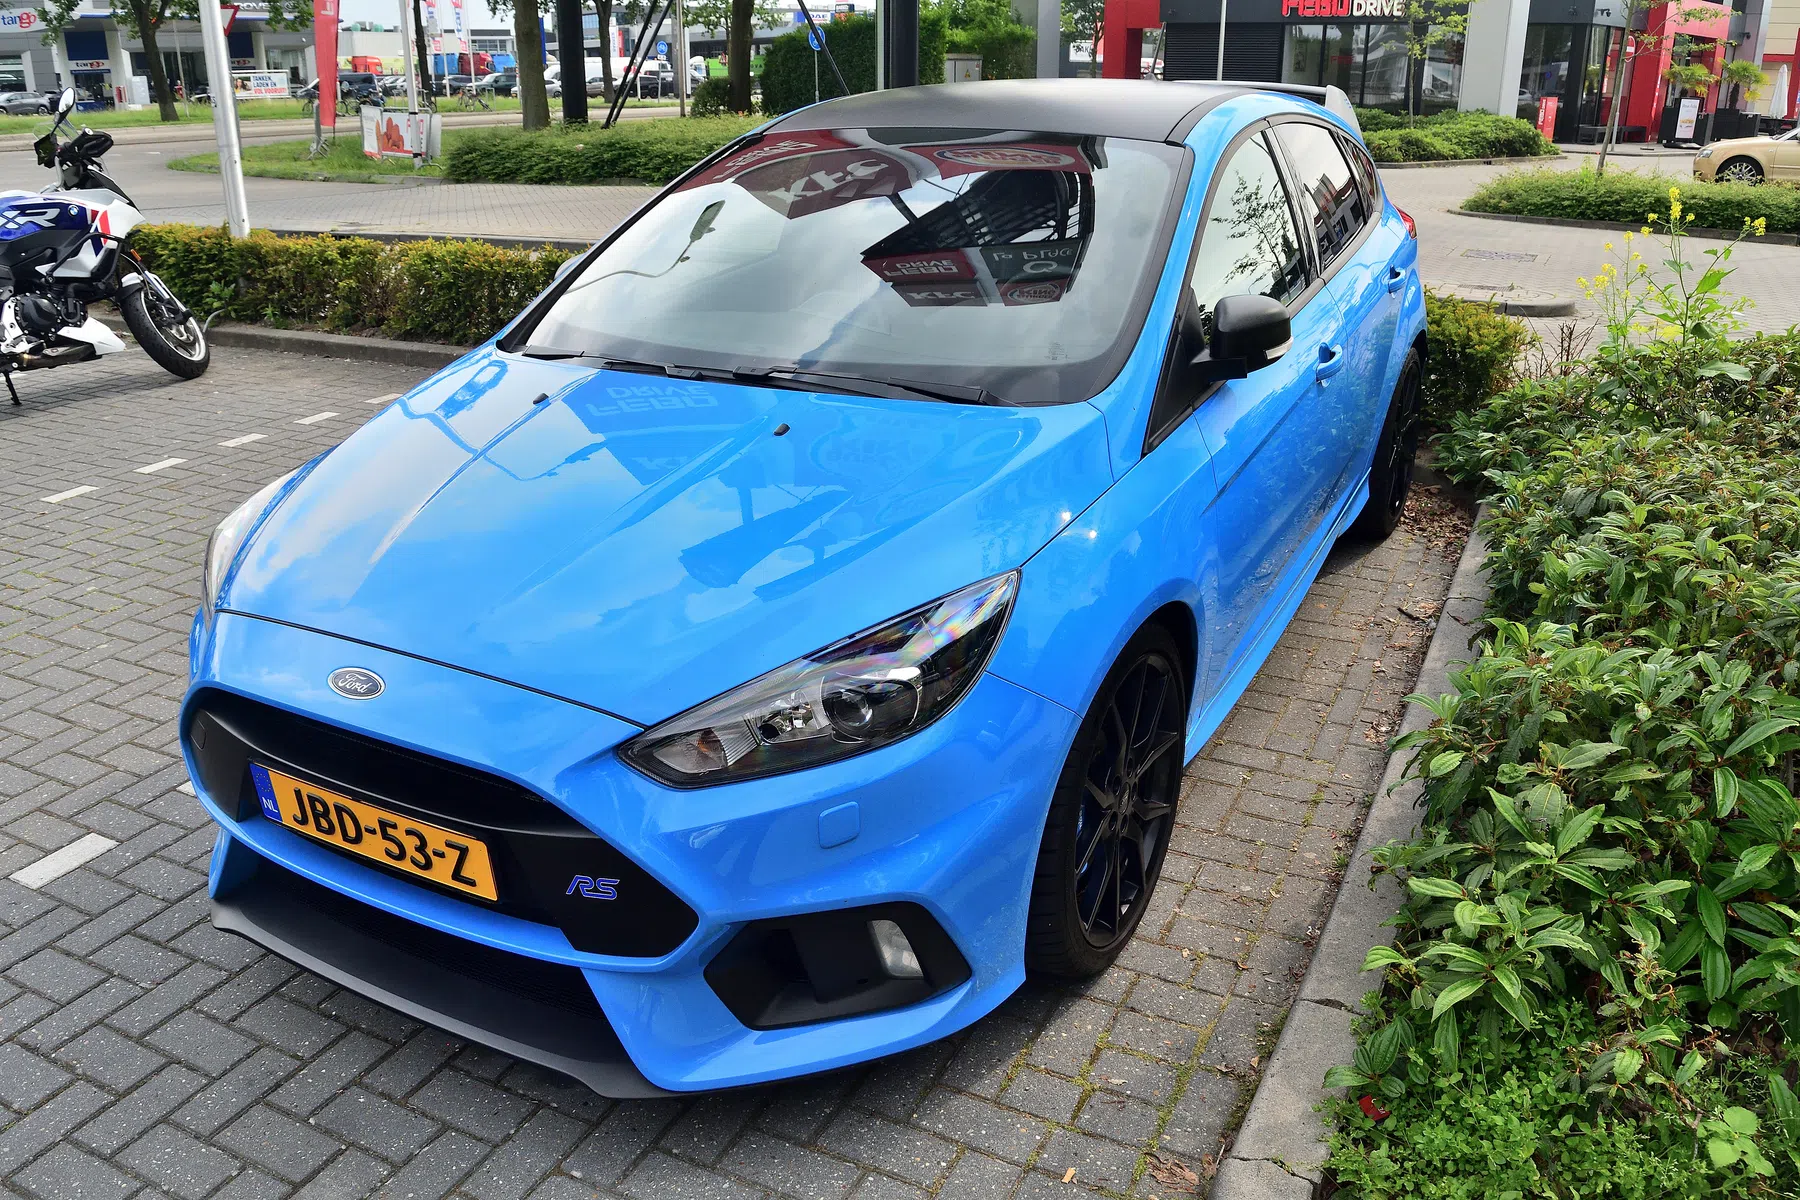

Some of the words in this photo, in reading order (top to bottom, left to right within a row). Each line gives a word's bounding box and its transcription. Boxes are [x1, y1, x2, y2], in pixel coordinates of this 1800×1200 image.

[233, 2, 279, 10] ROVE
[1352, 0, 1404, 17] DRIVE
[1, 12, 37, 28] tango
[338, 673, 373, 693] Ford
[261, 796, 279, 813] NL
[292, 786, 477, 887] JBD-53-Z
[565, 874, 620, 900] RS
